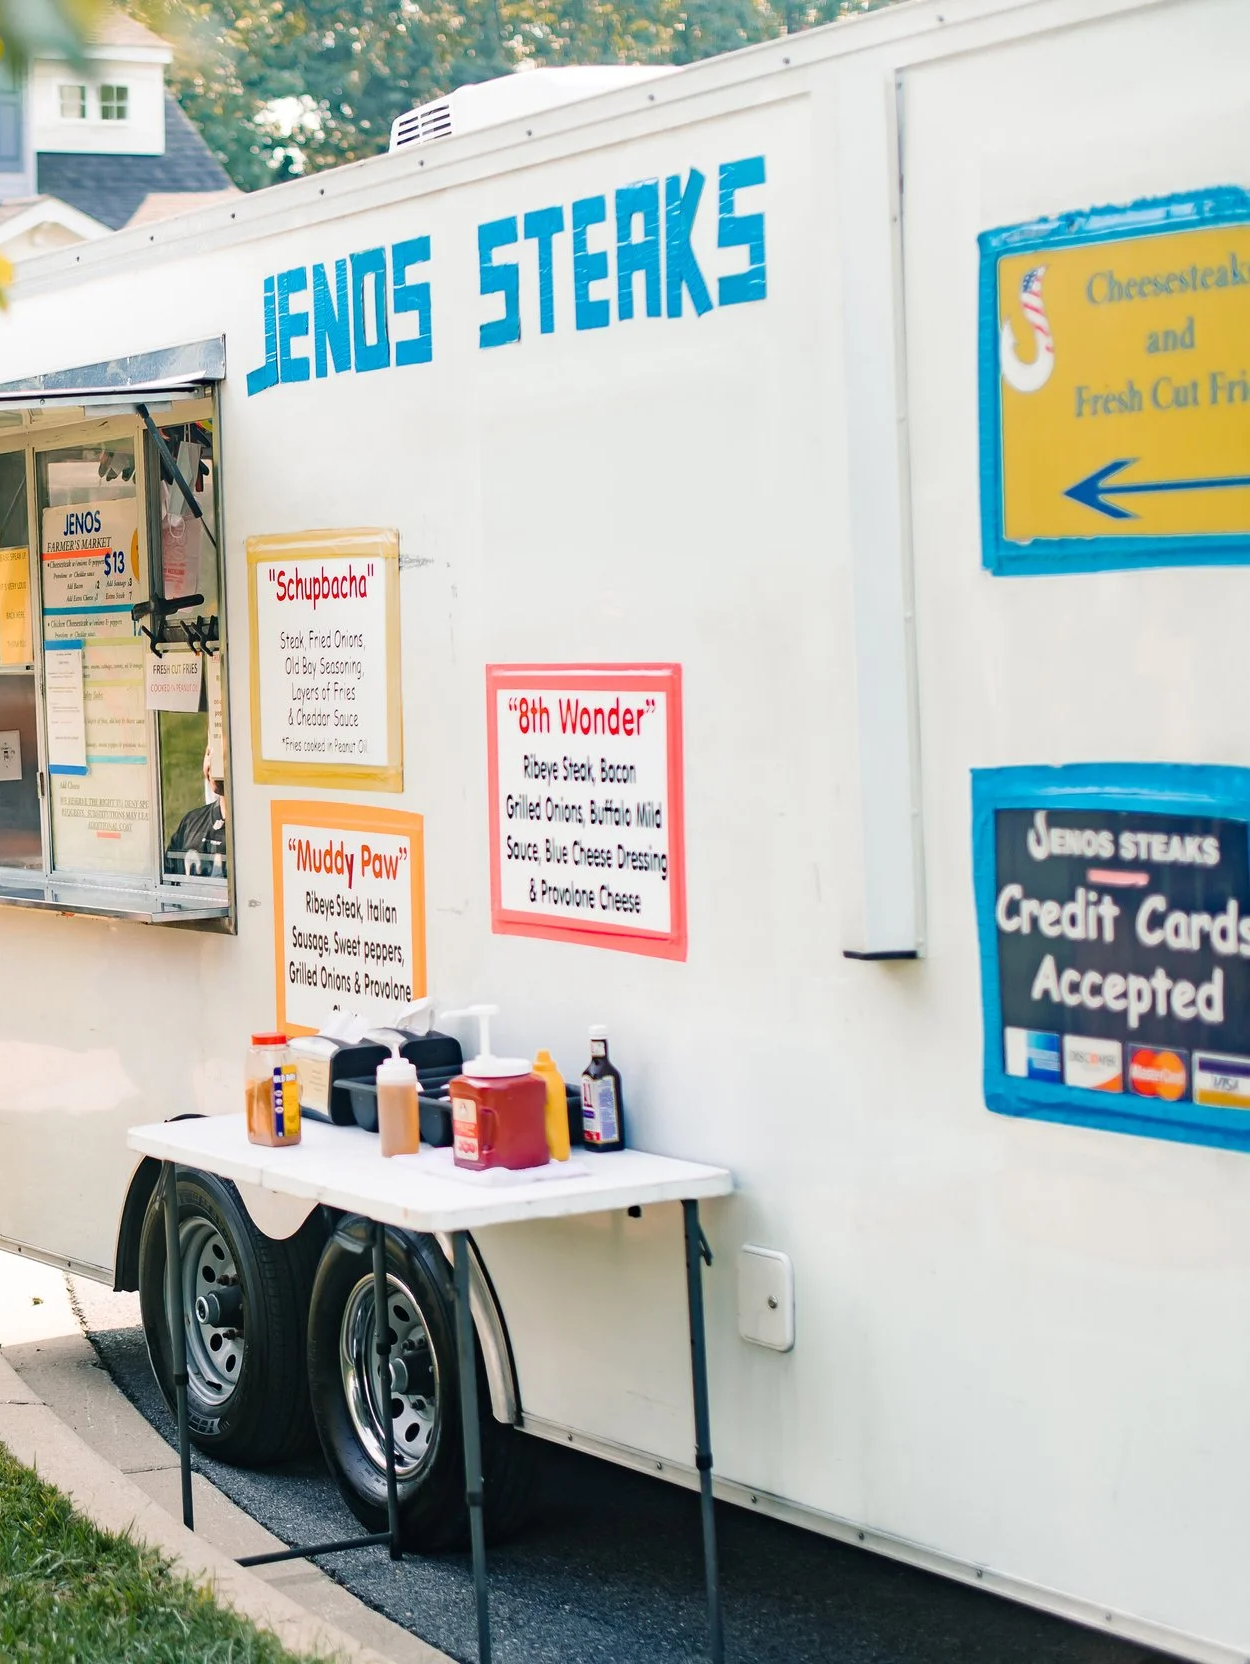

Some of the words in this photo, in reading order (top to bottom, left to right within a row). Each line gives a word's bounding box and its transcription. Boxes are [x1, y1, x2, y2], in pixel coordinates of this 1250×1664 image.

[246, 235, 432, 397] JENOS
[478, 155, 766, 349] STEAKS
[1086, 252, 1250, 305] Cheesesteak
[1146, 317, 1196, 354] and
[1075, 380, 1143, 418] Fresh
[1152, 375, 1199, 412] Cut
[63, 510, 101, 536] JENOS
[47, 539, 80, 553] FARMER'S
[81, 536, 112, 549] MARKET
[104, 551, 125, 577] $13
[269, 563, 374, 610] "Schupbacha"
[280, 630, 306, 650] Steak,
[309, 630, 331, 649] Fried
[334, 629, 366, 650] Onions,
[153, 664, 170, 675] FRESH
[171, 664, 181, 674] CUT
[183, 663, 198, 674] FRIES
[285, 657, 300, 675] Old
[302, 657, 317, 680] Bay
[320, 657, 365, 680] Seasoning,
[150, 684, 170, 692] COOKED
[291, 682, 319, 706] Layers
[321, 682, 330, 701] of
[333, 682, 356, 701] Fries
[288, 708, 294, 726] &
[296, 708, 330, 727] Cheddar
[334, 708, 359, 727] Sauce
[509, 697, 550, 734] “8th
[559, 697, 656, 736] Wonder”
[303, 738, 325, 752] cooked
[327, 739, 333, 752] in
[334, 738, 356, 753] Peanut
[524, 754, 558, 787] Ribeye
[562, 755, 595, 786] Steak,
[600, 757, 637, 784] Bacon
[506, 794, 542, 821] Grilled
[545, 796, 586, 828] Onions,
[590, 799, 631, 827] Buffalo
[636, 801, 662, 829] Mild
[1027, 809, 1115, 861] JENOS
[1119, 830, 1221, 866] STEAKS
[288, 838, 355, 889] “Muddy
[361, 845, 408, 880] Paw”
[507, 834, 541, 866] Sauce,
[545, 838, 568, 864] Blue
[572, 839, 612, 869] Cheese
[617, 844, 668, 881] Dressing
[306, 890, 335, 922] Ribeye
[336, 894, 363, 924] Steak,
[366, 898, 397, 925] Italian
[529, 877, 537, 902] &
[541, 878, 595, 909] Provolone
[600, 883, 641, 914] Cheese
[996, 883, 1120, 943] Credit
[292, 926, 331, 958] Sausage,
[334, 932, 360, 957] Sweet
[364, 940, 405, 967] peppers,
[289, 961, 317, 987] Grilled
[321, 967, 351, 994] Onions
[354, 972, 361, 994] &
[364, 974, 412, 1003] Provolone
[1032, 954, 1224, 1029] Accepted
